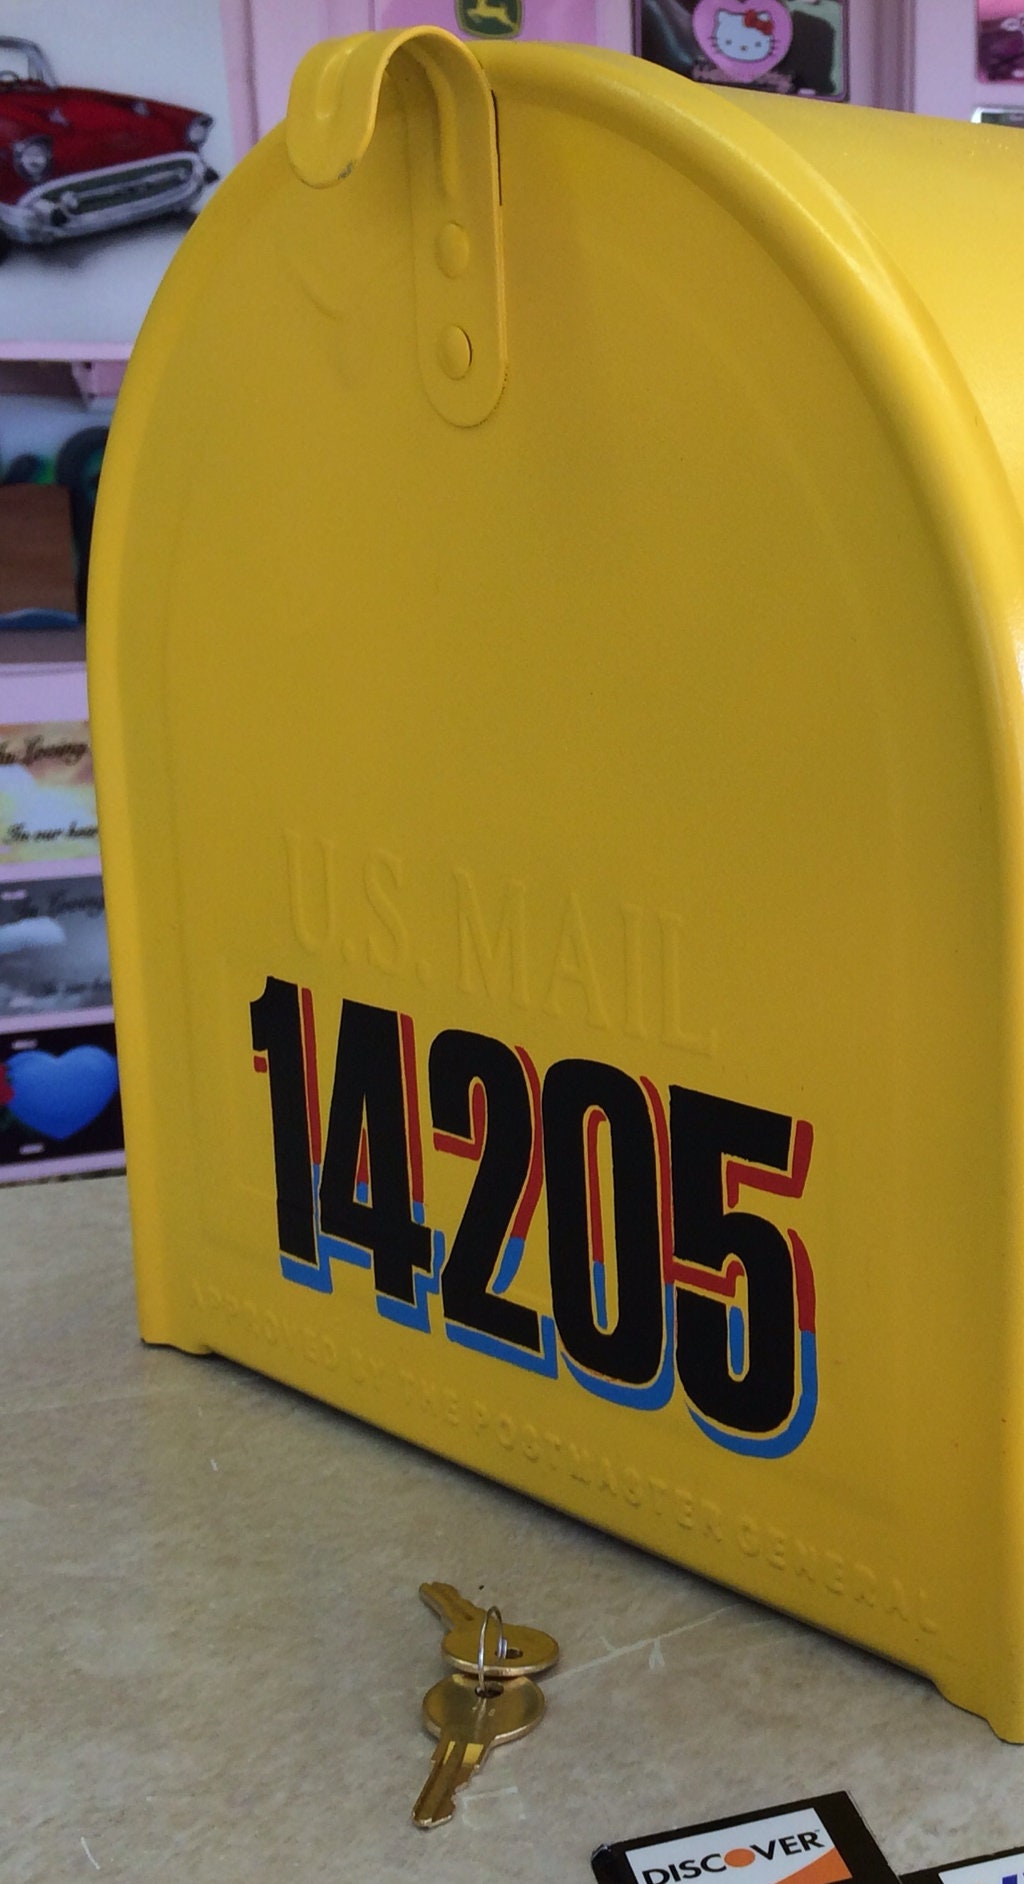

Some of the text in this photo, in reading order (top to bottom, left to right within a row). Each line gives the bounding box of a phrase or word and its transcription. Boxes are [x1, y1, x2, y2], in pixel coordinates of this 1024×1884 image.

[281, 827, 716, 1058] U.S. MAIL
[250, 976, 817, 1458] 14205
[471, 1398, 724, 1545] POSTMASTER
[735, 1510, 940, 1636] GENERAL
[642, 1831, 825, 1884] DISCOVER
